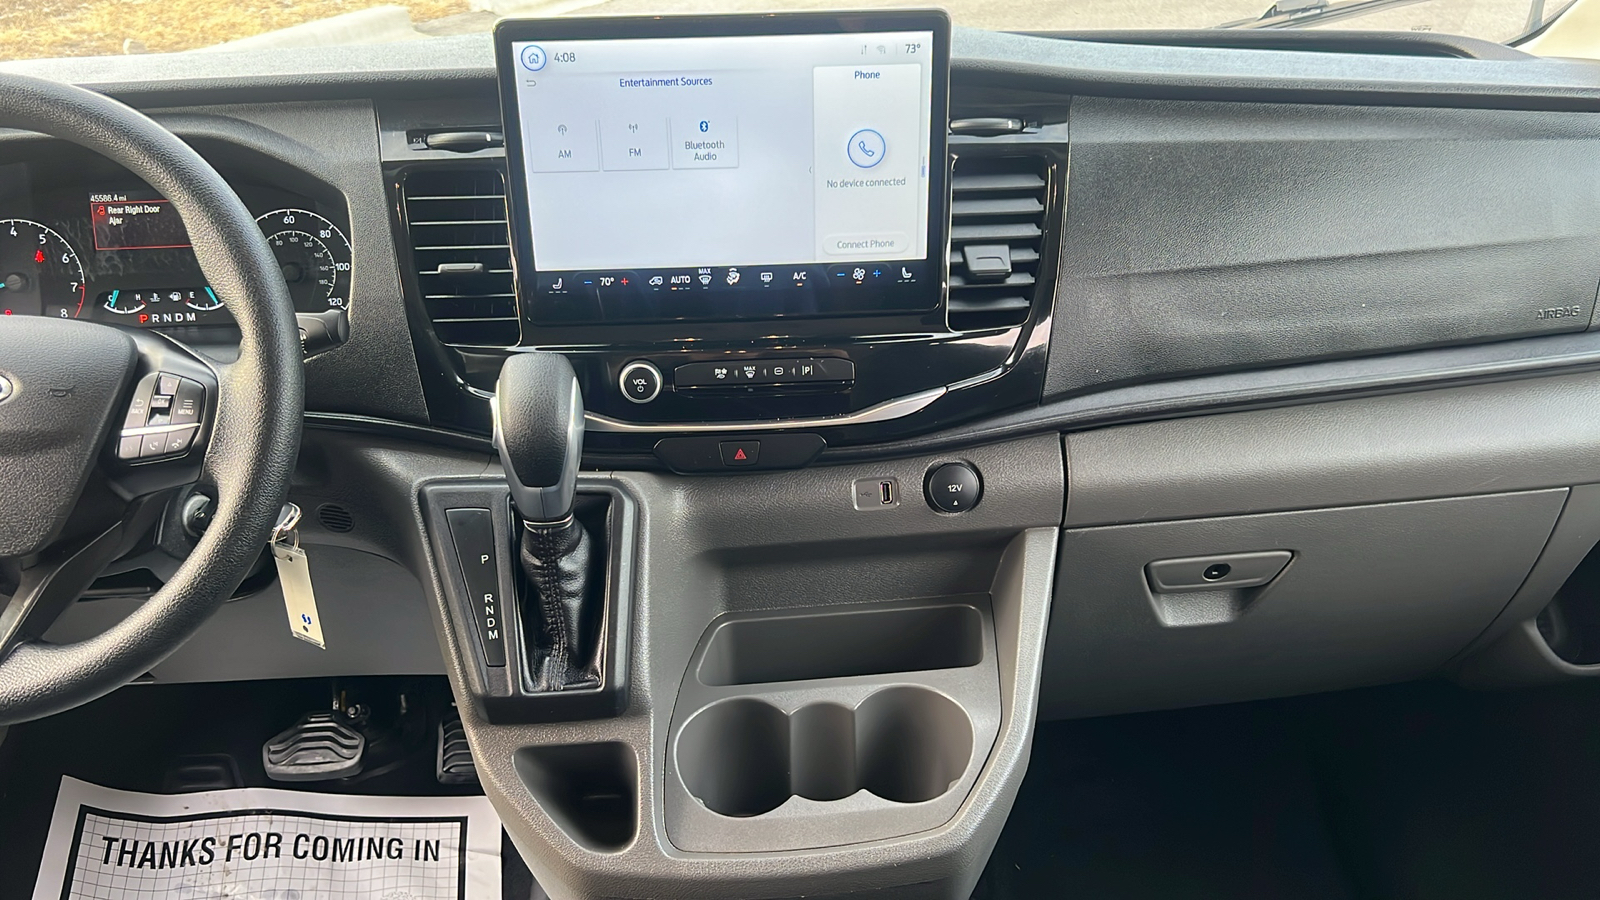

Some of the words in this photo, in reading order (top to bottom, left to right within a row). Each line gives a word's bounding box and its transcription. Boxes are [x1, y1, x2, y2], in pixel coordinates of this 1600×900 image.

[554, 52, 576, 63] 4:08
[854, 70, 880, 80] Phone
[619, 78, 679, 88] Entertainment
[680, 77, 713, 87] Sources
[684, 140, 725, 150] Bluetooth
[558, 149, 572, 159] AM
[628, 148, 642, 157] FM
[693, 152, 717, 161] Audio
[826, 179, 838, 188] No
[839, 178, 865, 188] device
[865, 177, 906, 187] connected
[107, 206, 124, 215] Rear
[124, 206, 144, 216] Right
[144, 205, 160, 214] Door
[108, 216, 123, 226] Ajar
[283, 215, 295, 224] 60
[10, 226, 18, 237] 4
[319, 229, 331, 238] 80
[38, 233, 46, 244] 5
[837, 240, 868, 250] Connect
[869, 239, 895, 249] Phone
[61, 252, 70, 263] 6
[335, 262, 350, 271] 100
[698, 267, 712, 275] MAX
[670, 275, 691, 285] AUTO
[792, 271, 807, 281] A/C
[70, 282, 78, 293] 7
[189, 291, 195, 299] E
[327, 297, 342, 306] 120
[60, 308, 68, 318] 8
[139, 314, 149, 323] P
[151, 313, 160, 323] R
[163, 313, 172, 322] N
[174, 312, 183, 322] D
[186, 312, 196, 322] M
[1535, 305, 1580, 320] AIRBAG
[632, 378, 648, 386] VOL
[947, 484, 963, 492] 12V
[481, 554, 489, 565] P
[484, 593, 494, 604] R
[485, 605, 494, 616] N
[486, 617, 496, 628] D
[488, 629, 499, 641] M
[102, 836, 216, 870] THANKS
[225, 832, 283, 863] FOR
[292, 833, 404, 863] COMING
[414, 839, 440, 862] IN
